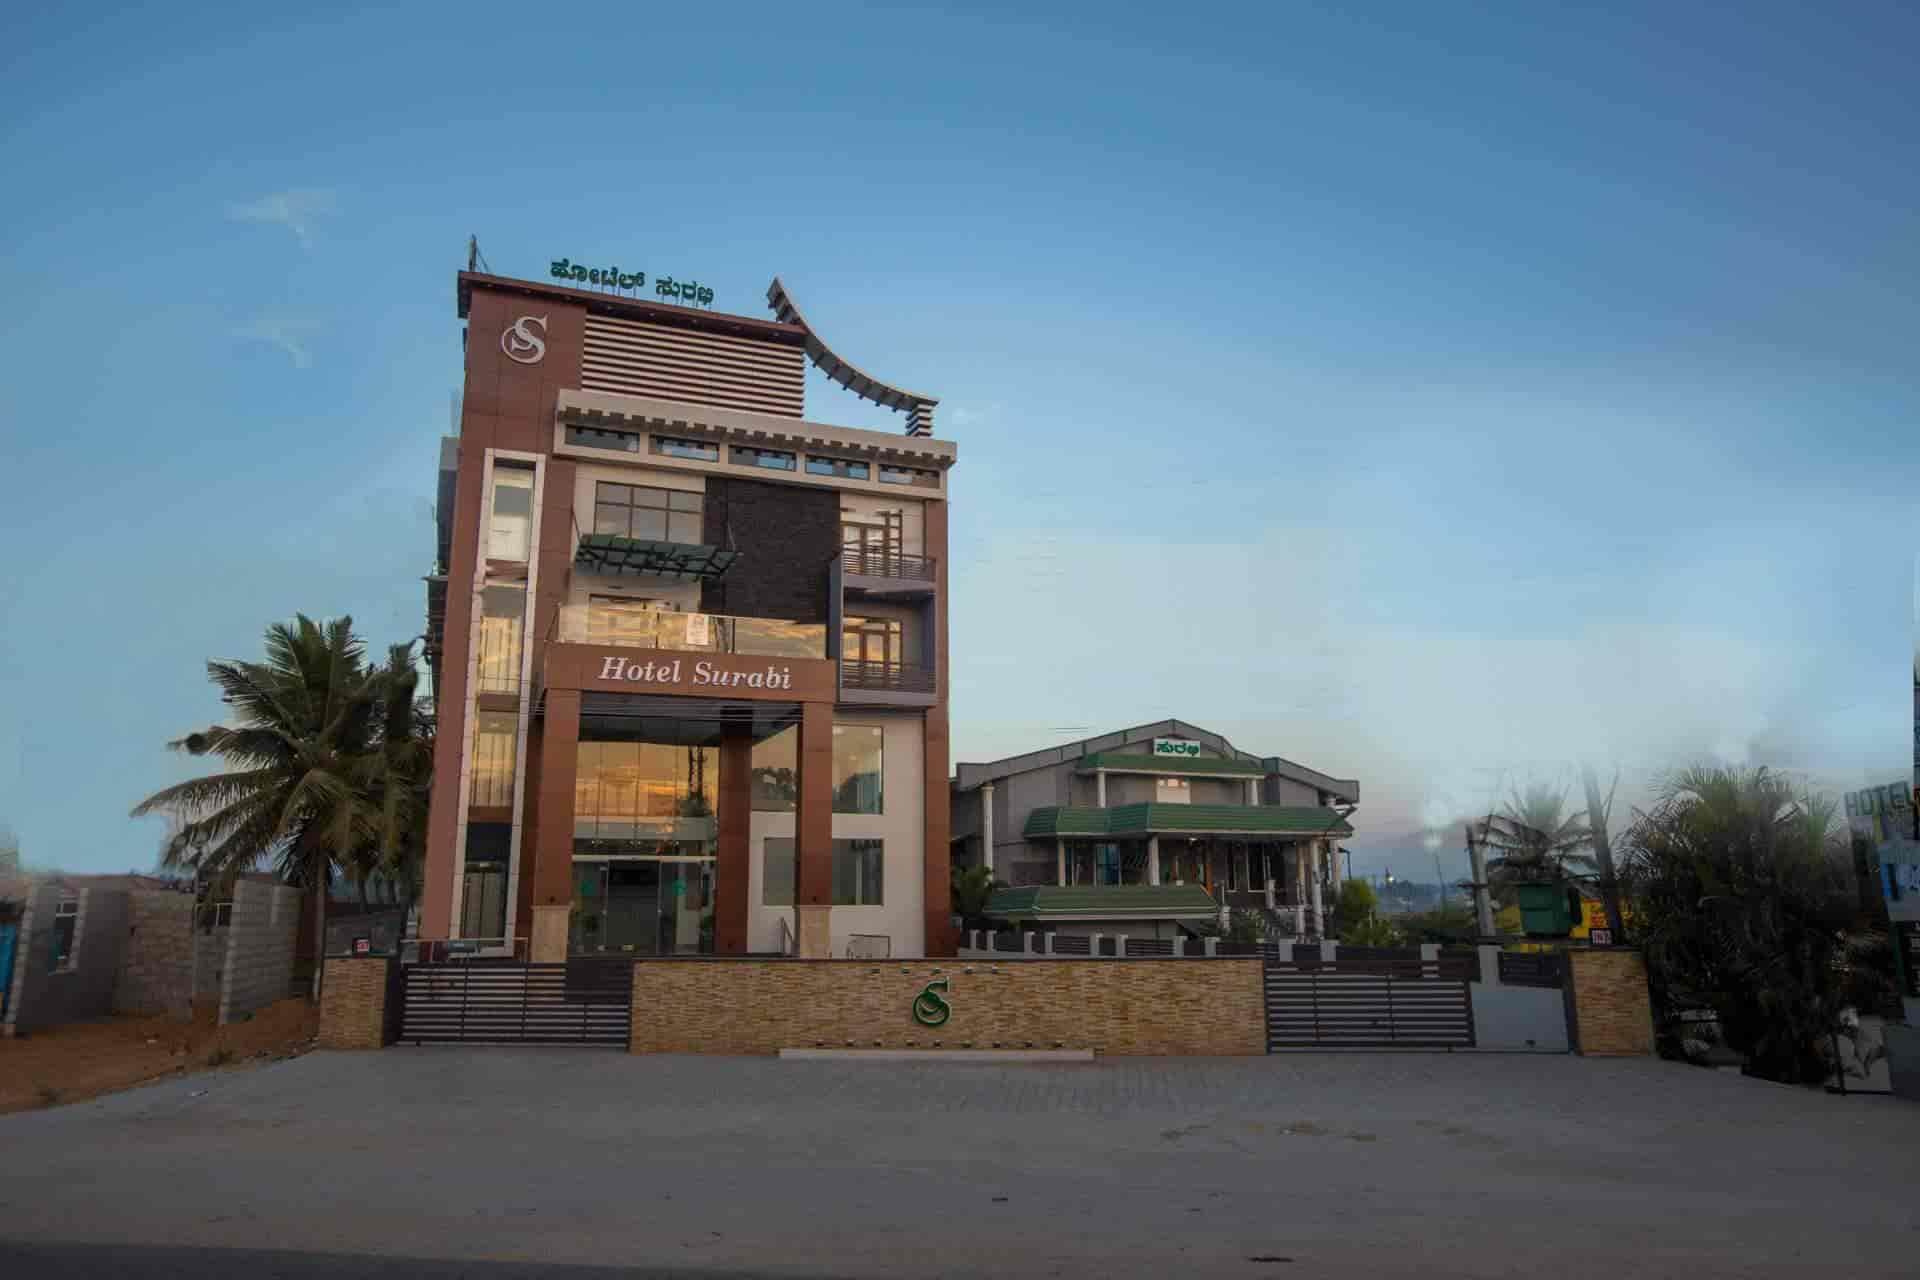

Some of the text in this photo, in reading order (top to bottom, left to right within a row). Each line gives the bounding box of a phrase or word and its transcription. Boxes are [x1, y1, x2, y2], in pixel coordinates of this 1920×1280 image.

[550, 258, 714, 306] ಹೋಟೆಲ್ ಸುರಭಿ
[598, 656, 792, 690] Hotel Surabi
